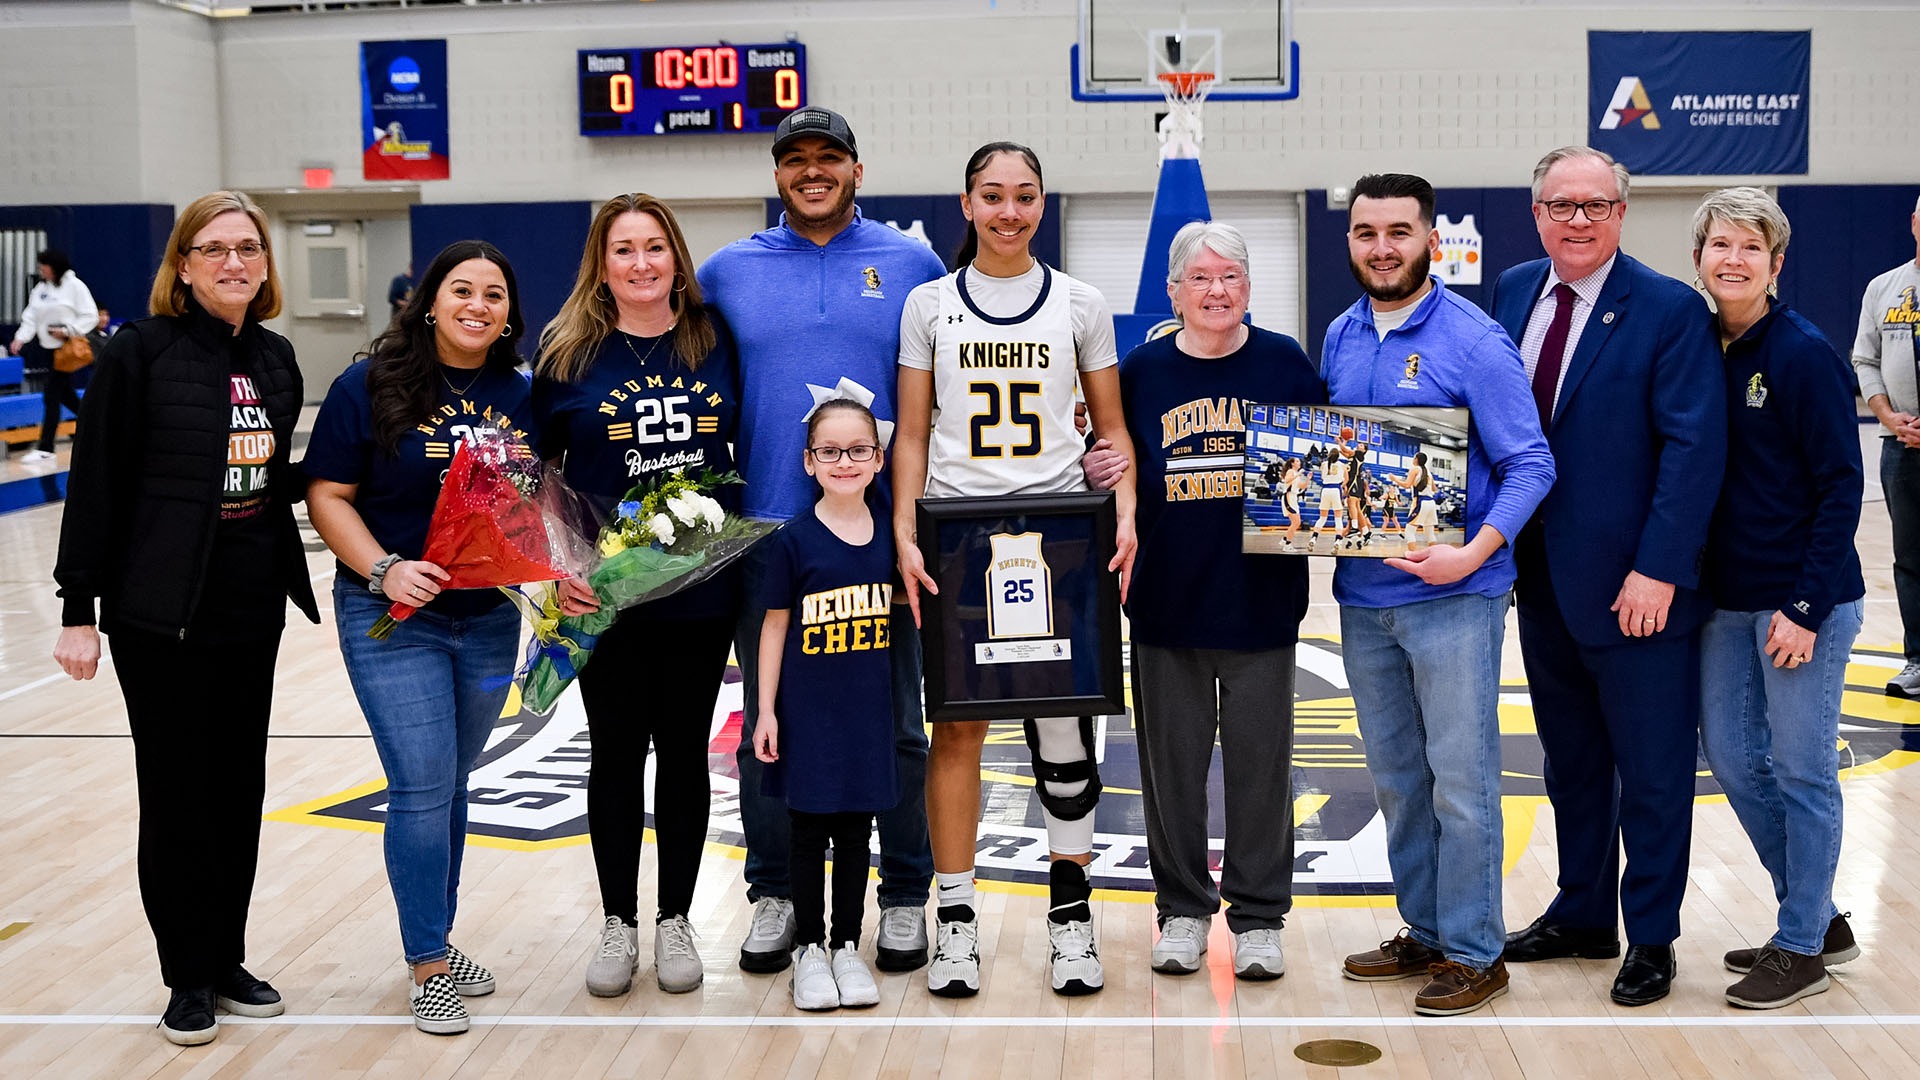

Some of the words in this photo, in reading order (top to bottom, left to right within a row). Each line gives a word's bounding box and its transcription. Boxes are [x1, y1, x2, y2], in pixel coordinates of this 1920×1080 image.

[587, 54, 626, 73] Home
[654, 47, 738, 89] 10:00
[746, 49, 795, 68] Guests
[609, 74, 634, 113] 0
[774, 69, 799, 109] 0
[1670, 94, 1753, 110] ATLANTIC
[1757, 94, 1800, 110] EAST
[668, 109, 711, 128] period
[732, 102, 743, 129] 1
[1689, 111, 1781, 126] CONFERENCE
[959, 342, 1050, 369] KNIGHTS
[231, 377, 262, 400] TH
[598, 374, 723, 417] NEUMANN
[229, 405, 273, 429] ACK
[416, 399, 529, 437] NEUMANN
[635, 395, 692, 444] 25
[967, 380, 1043, 460] 25
[1161, 397, 1246, 448] NEUMA
[1172, 446, 1192, 455] ASTON
[1203, 436, 1235, 453] 1965
[624, 448, 705, 477] Basketball
[1003, 578, 1034, 604] 25
[802, 618, 890, 655] CHEE
